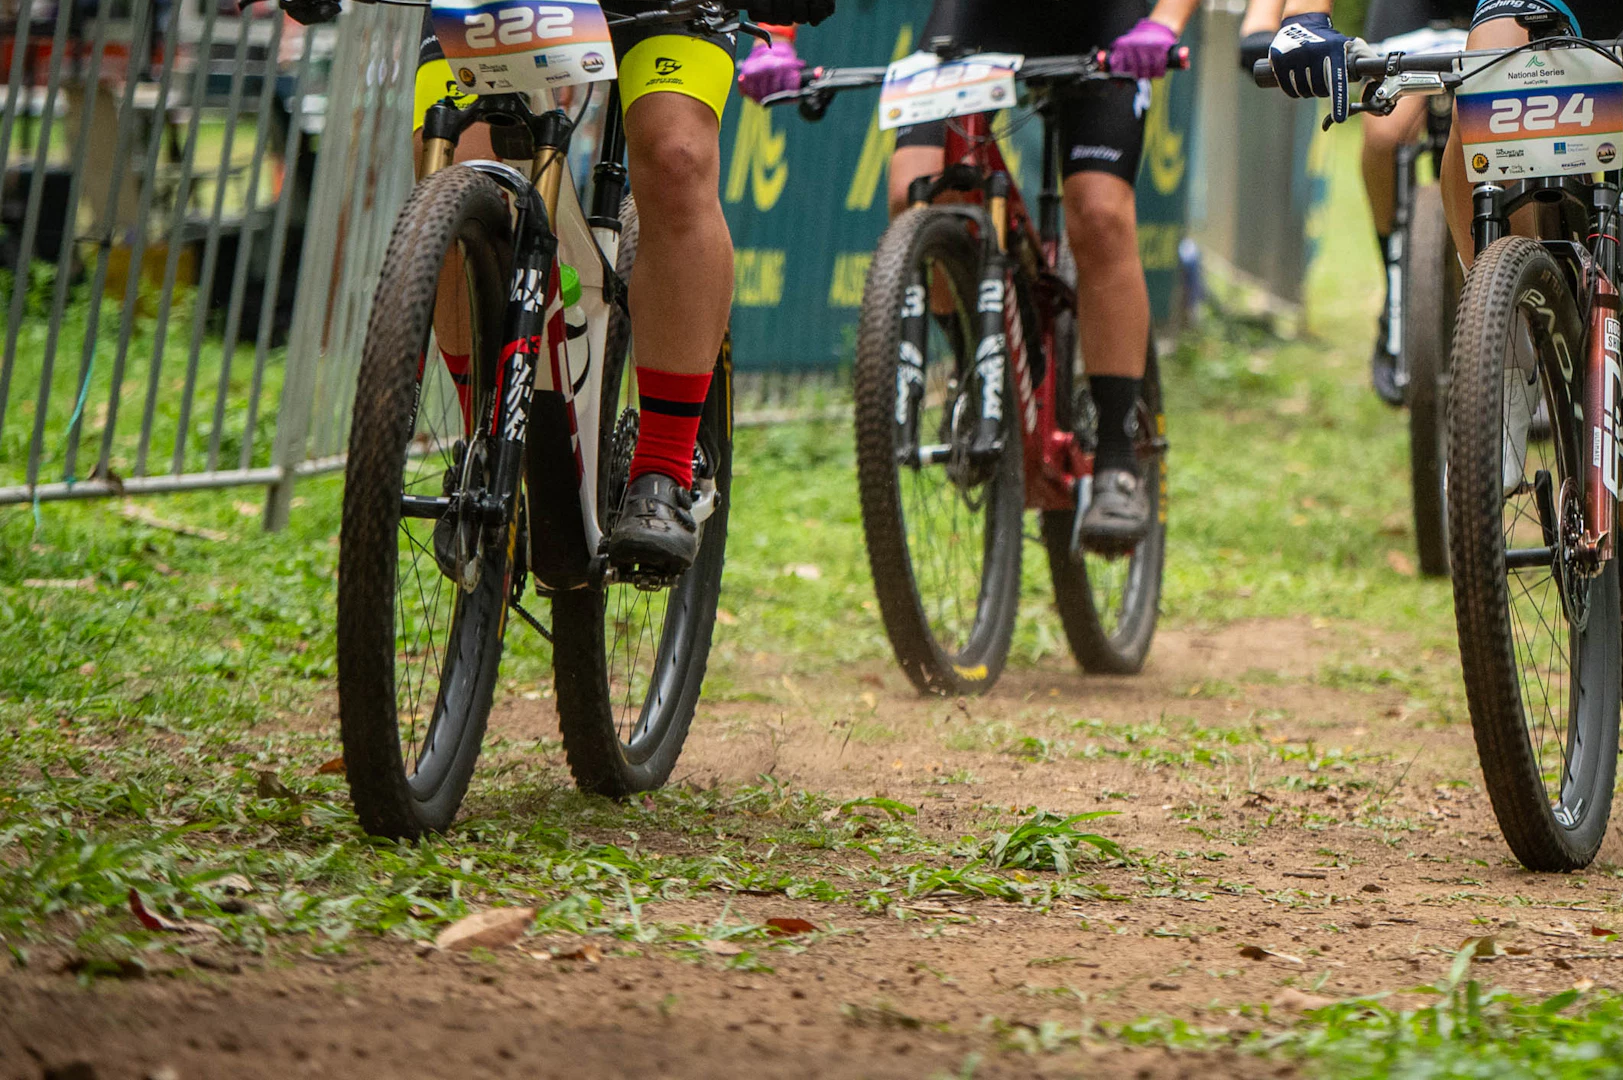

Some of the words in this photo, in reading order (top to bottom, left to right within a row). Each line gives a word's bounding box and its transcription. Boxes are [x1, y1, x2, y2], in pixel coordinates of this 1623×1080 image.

[464, 6, 574, 50] 222
[1507, 70, 1539, 80] National
[1539, 68, 1565, 78] Series
[1489, 92, 1594, 134] 224
